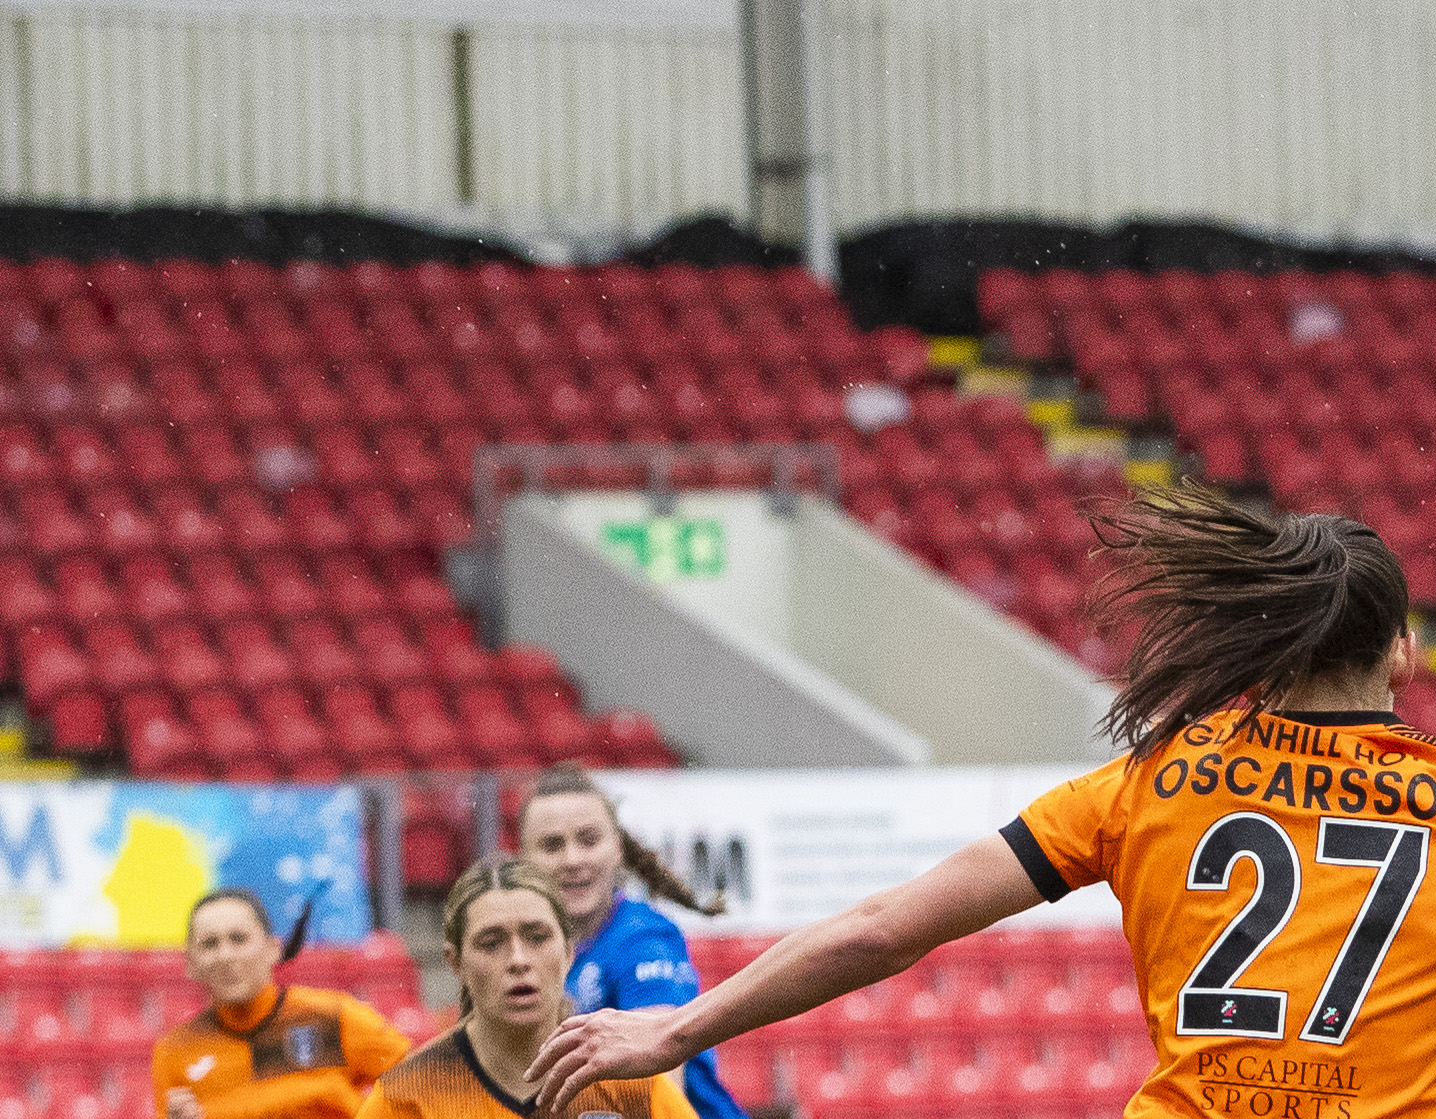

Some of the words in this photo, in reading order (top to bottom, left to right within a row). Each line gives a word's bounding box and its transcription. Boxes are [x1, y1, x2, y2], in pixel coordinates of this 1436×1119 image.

[1183, 718, 1341, 758] GLNHILL
[1177, 811, 1430, 1045] 27
[1197, 1052, 1229, 1077] PS
[1236, 1056, 1363, 1091] CAPITAL
